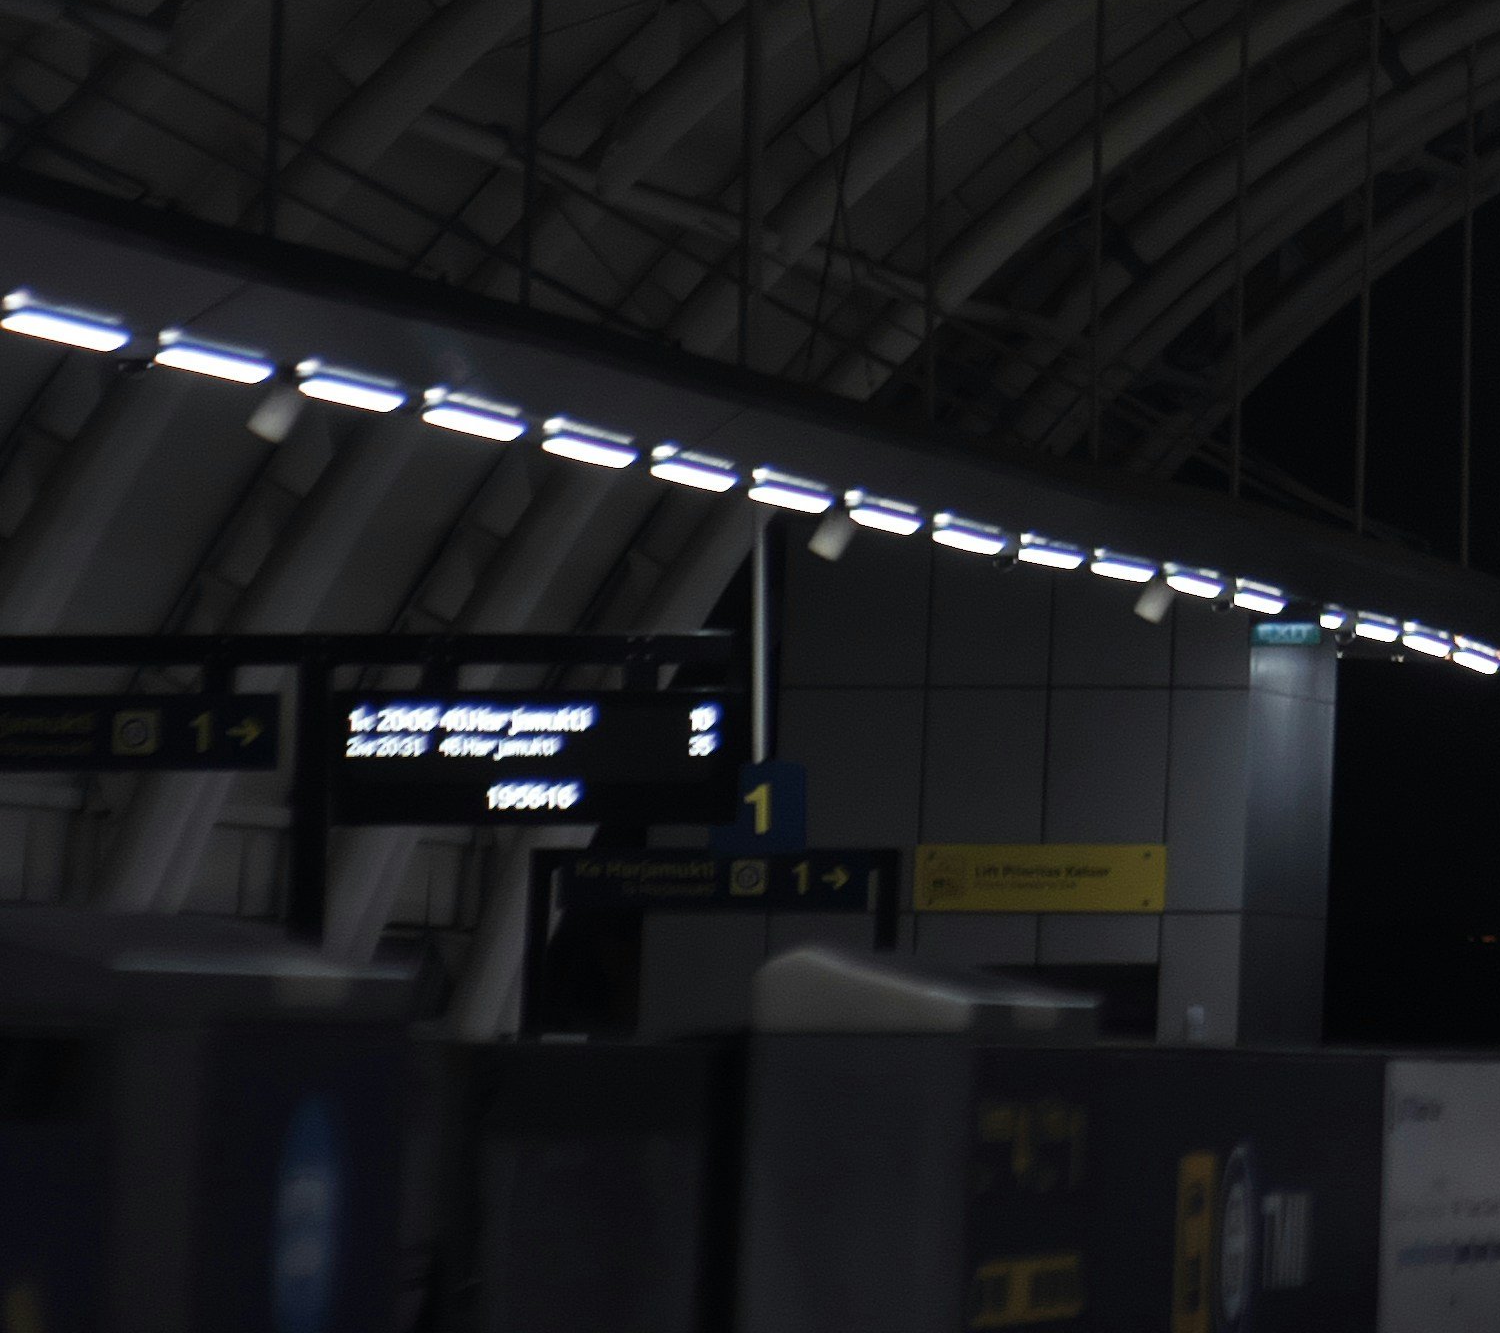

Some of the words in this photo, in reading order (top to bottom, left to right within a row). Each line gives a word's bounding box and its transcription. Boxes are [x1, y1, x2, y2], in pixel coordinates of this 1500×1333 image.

[189, 710, 213, 754] 1
[746, 784, 768, 834] 1
[791, 860, 811, 896] 1
